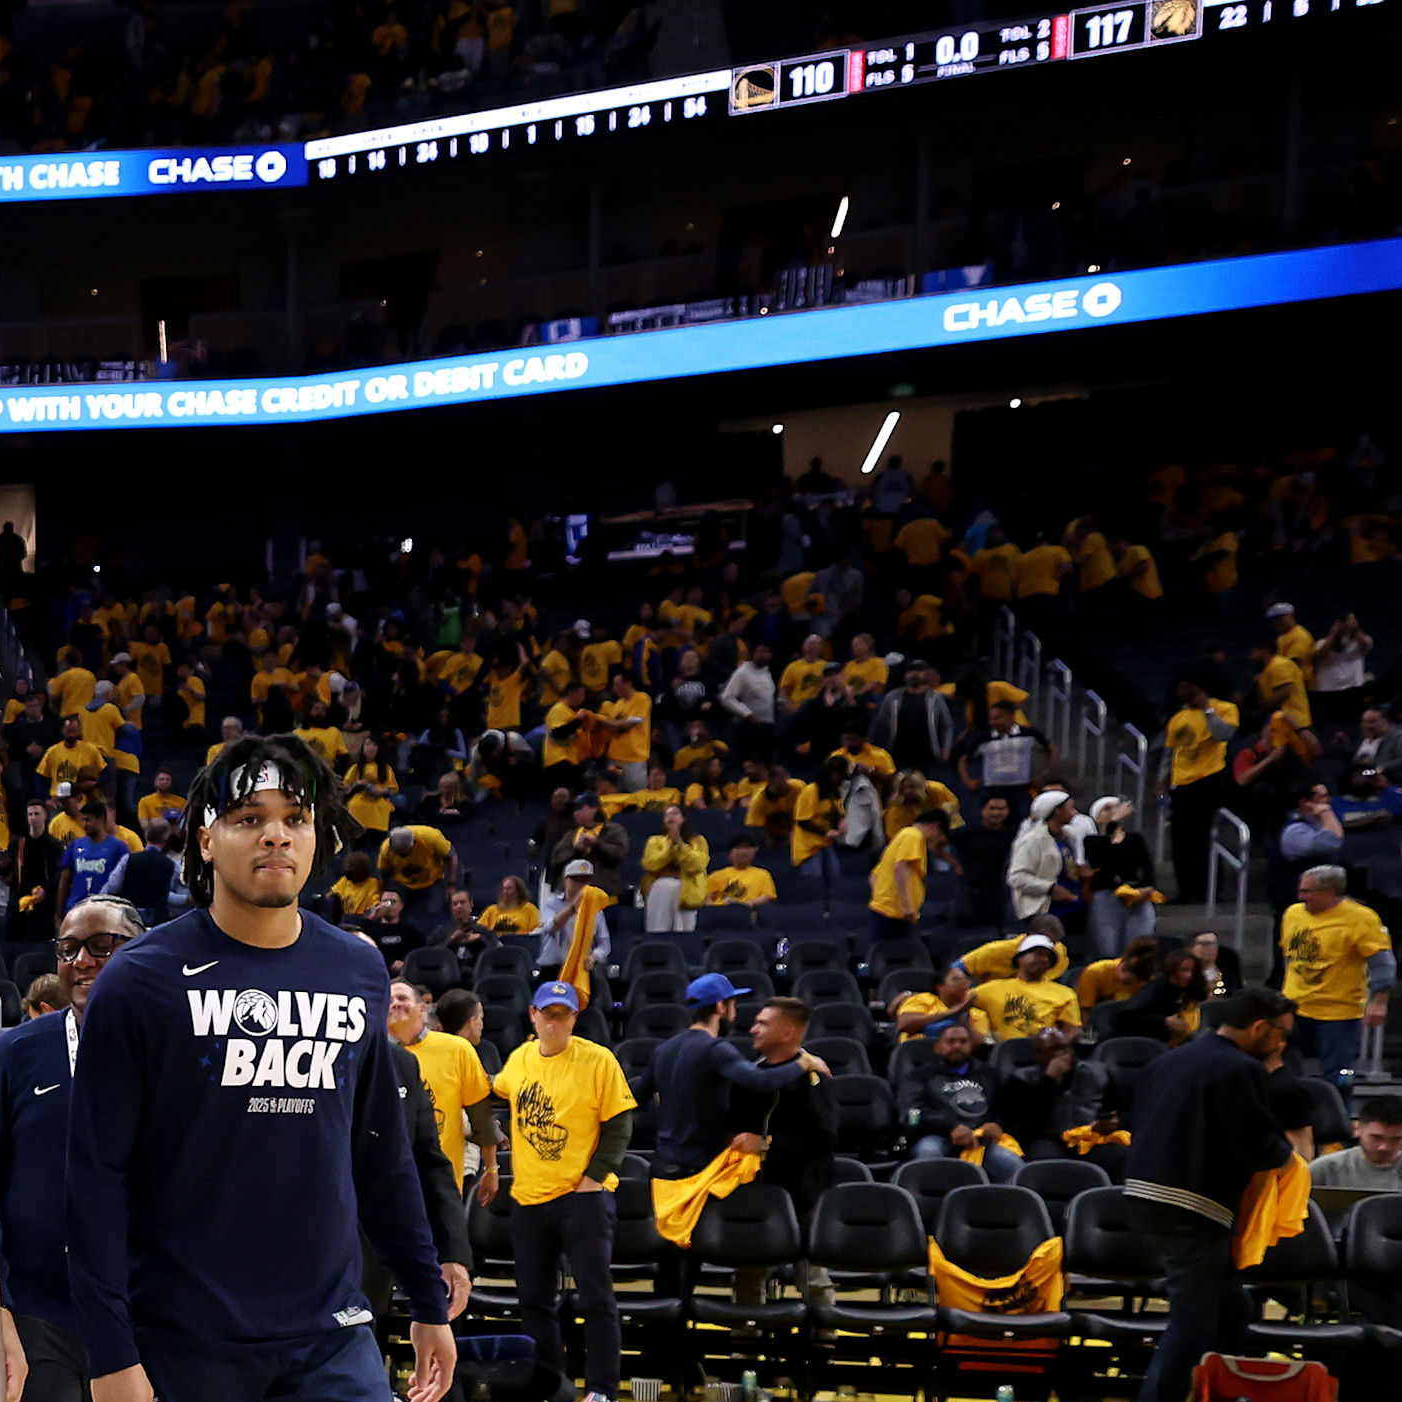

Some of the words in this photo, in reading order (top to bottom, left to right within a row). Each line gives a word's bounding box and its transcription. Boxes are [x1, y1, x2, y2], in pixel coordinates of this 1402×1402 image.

[1036, 18, 1051, 40] 2
[1085, 10, 1134, 48] 117
[904, 42, 915, 61] 1
[935, 31, 979, 65] 0.0
[789, 61, 834, 97] 110
[29, 160, 120, 189] CHASE
[148, 155, 254, 184] CHASE
[943, 290, 1079, 331] CHASE
[8, 395, 81, 422] WITH
[85, 392, 163, 419] YOUR
[167, 389, 257, 417] CHASE
[261, 380, 360, 414] CREDIT
[364, 374, 408, 402] OR
[414, 362, 498, 397] DEBIT
[502, 352, 589, 385] CARD
[187, 988, 367, 1043] WOLVES
[220, 1038, 343, 1090] BACK
[277, 1097, 316, 1115] PLAYOFFS
